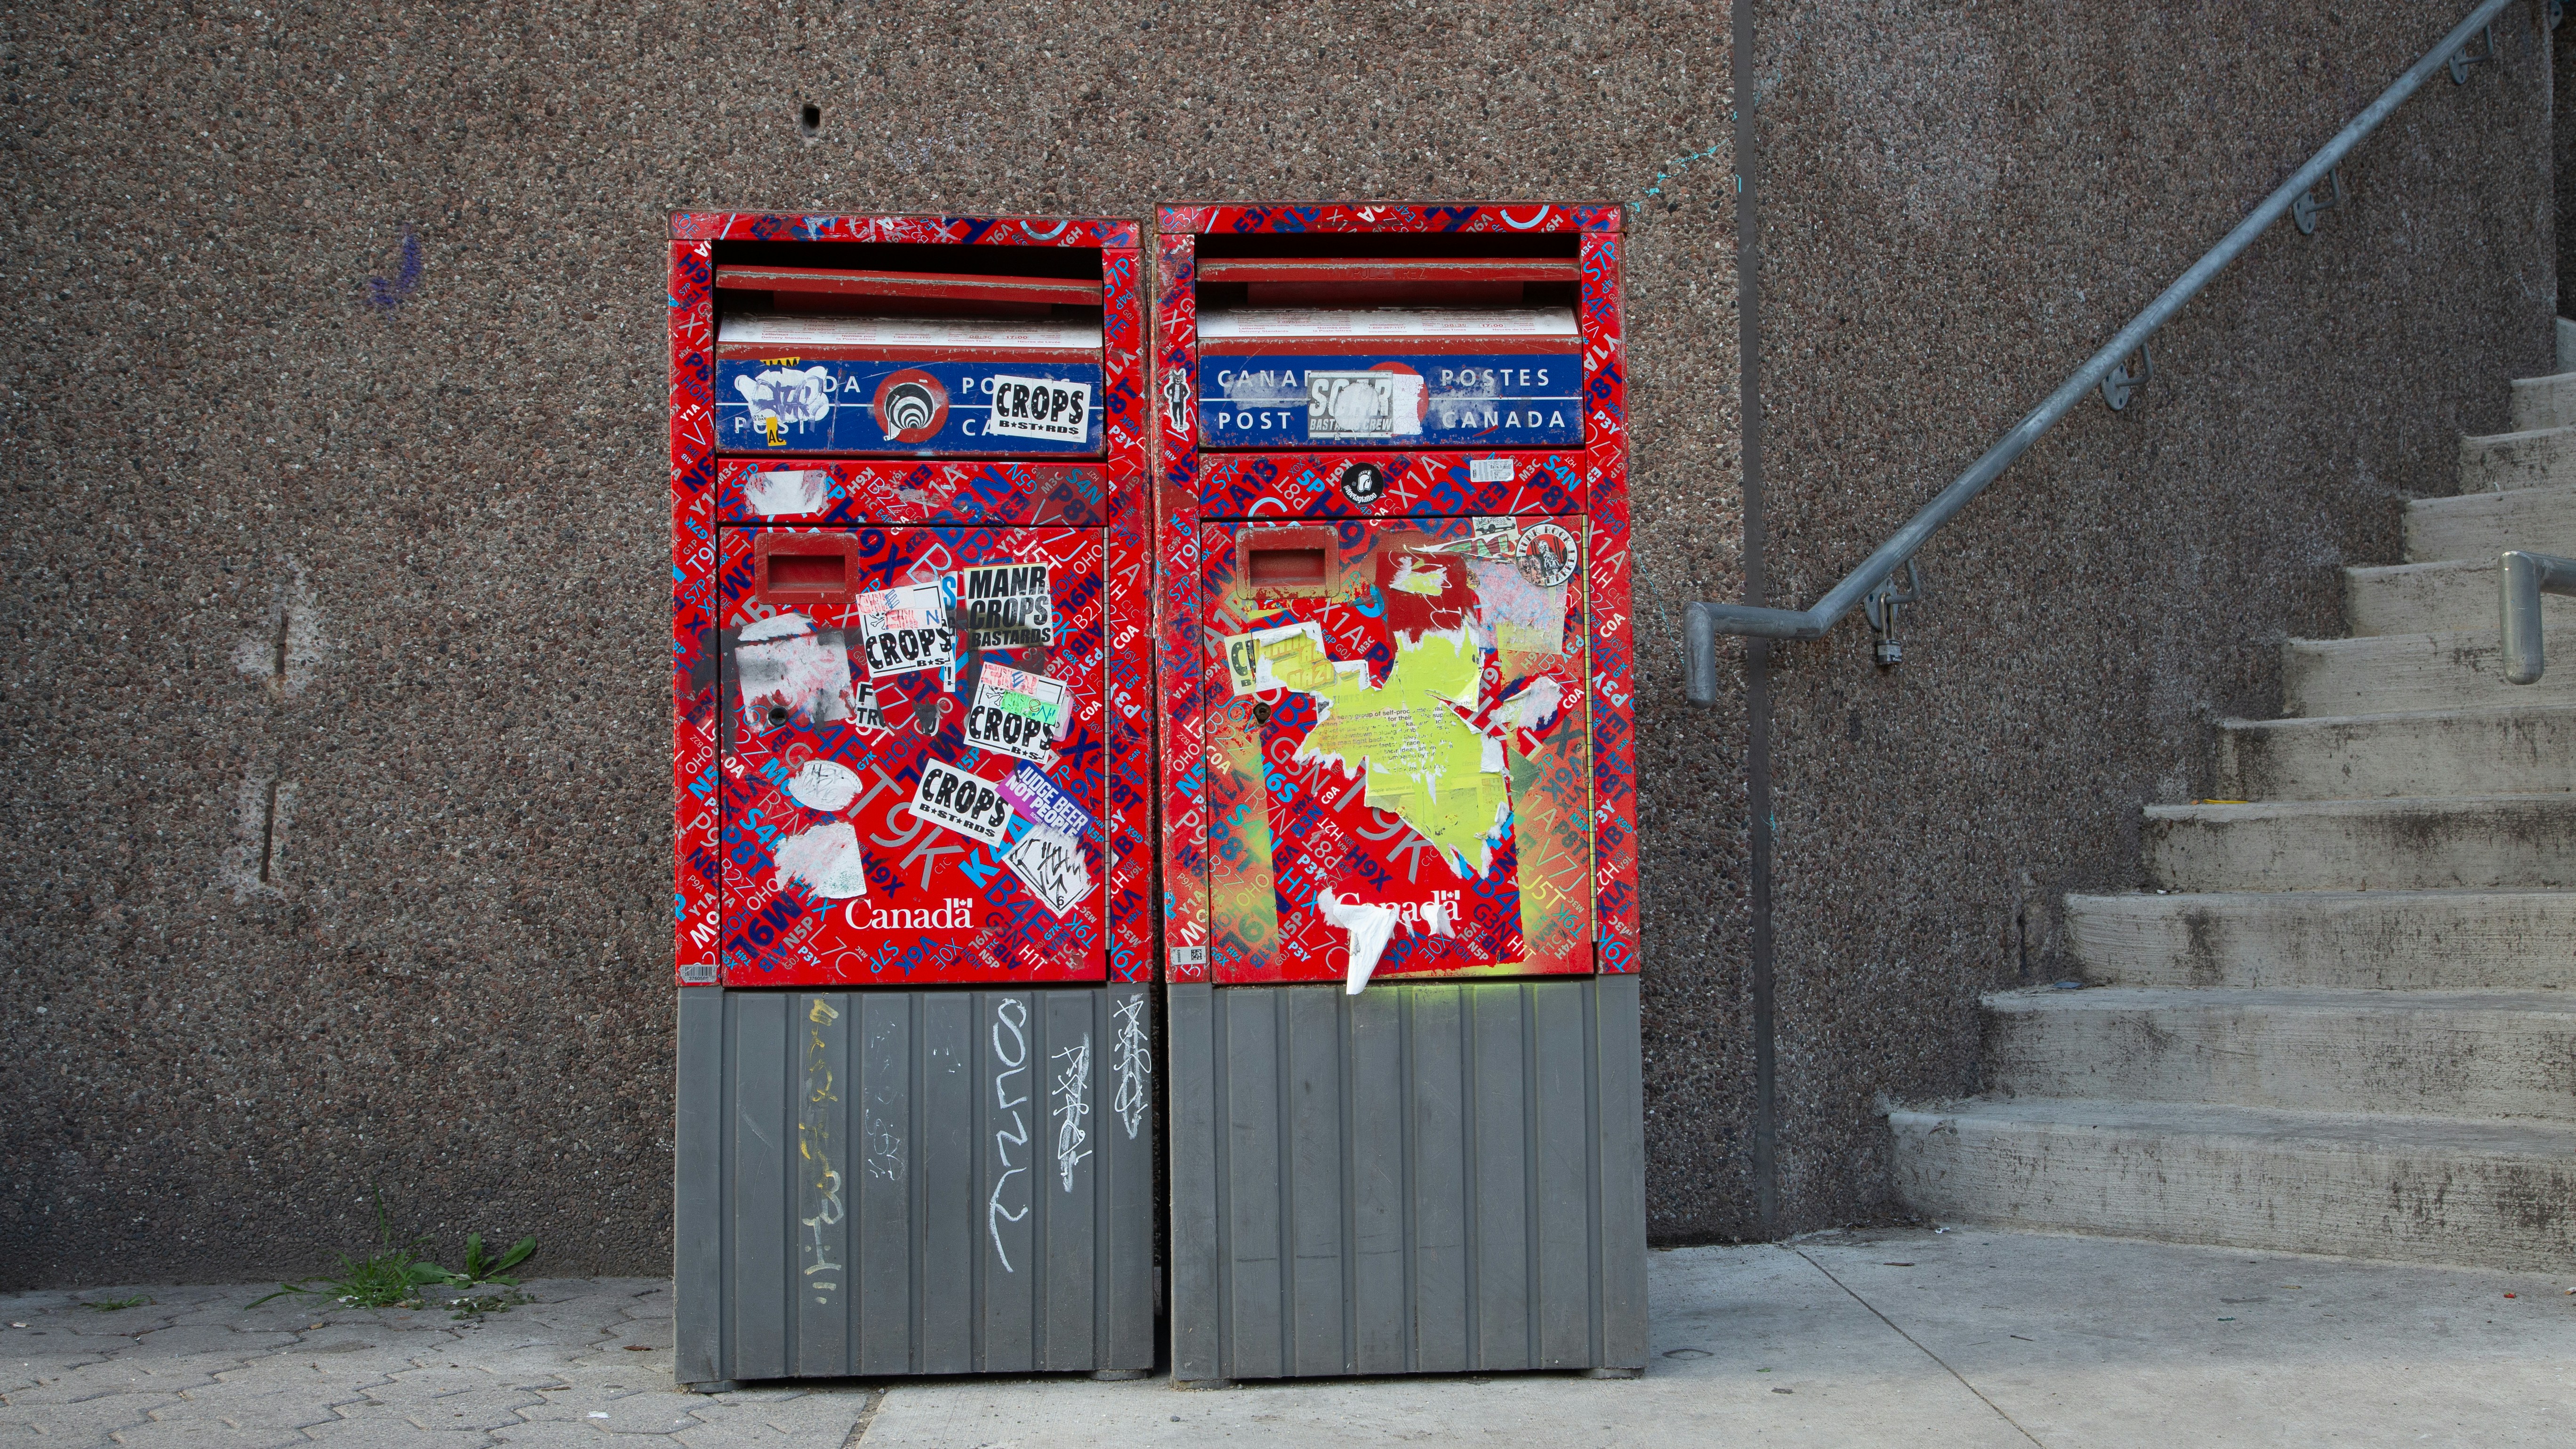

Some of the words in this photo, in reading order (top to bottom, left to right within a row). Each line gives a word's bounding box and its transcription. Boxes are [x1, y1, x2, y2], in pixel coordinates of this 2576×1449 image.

[1583, 242, 1616, 281] S7P
[1585, 333, 1620, 371] Y1A
[1442, 370, 1549, 386] POSTES
[680, 404, 700, 421] Y1A
[997, 383, 1084, 425] CROPS
[1219, 412, 1291, 429] POST
[1442, 411, 1565, 428] CANADA
[1594, 410, 1620, 435] P3Y
[1109, 425, 1134, 448] P3Y
[848, 467, 875, 496] K6H
[1006, 464, 1038, 495] G5N
[1040, 471, 1063, 495] M3C
[1212, 459, 1238, 490] S7P
[1229, 458, 1278, 510] A1B
[1390, 455, 1446, 508] X1A
[1518, 459, 1541, 482] M3C
[1543, 455, 1582, 492] S4N
[860, 492, 877, 510] T1C
[1065, 468, 1103, 505] S4N
[1272, 475, 1311, 511] P8T
[1527, 471, 1582, 517] P8T
[997, 527, 1027, 553] Y1A
[1519, 528, 1538, 554] PUNK
[1544, 525, 1572, 545] ROCK
[1546, 549, 1576, 584] MARKET
[684, 580, 706, 604] S7P
[968, 566, 1046, 599] MANR
[1169, 576, 1189, 602] S7P
[969, 596, 1049, 630] CROPS
[1073, 599, 1103, 629] B2J
[1314, 597, 1366, 651] X1A
[865, 617, 952, 670] CROPS
[972, 627, 1051, 648] BASTARDS
[1357, 636, 1375, 652] M3C
[1080, 647, 1103, 676] P3Y
[1612, 662, 1628, 677] G7K
[1056, 665, 1096, 706] B2Z
[1126, 674, 1141, 689] G7K
[1173, 681, 1192, 700] Y1A
[1592, 672, 1628, 708] P3Y
[969, 705, 1055, 751] CROPS
[1354, 713, 1373, 721] group
[857, 752, 877, 771] G7K
[1129, 749, 1141, 762] S4N
[1607, 751, 1632, 775] N5P
[1119, 763, 1144, 786] N5P
[1594, 764, 1632, 801] P8T
[922, 768, 1009, 828] CROPS
[1005, 774, 1035, 803] NOT
[1029, 796, 1080, 837] PEOPLE
[1017, 766, 1059, 805] JUDGE
[1052, 796, 1089, 832] BEER
[1126, 825, 1143, 843] G6X
[1290, 805, 1323, 837] B3N
[1317, 817, 1344, 842] H2T
[1615, 815, 1633, 834] G6X
[722, 824, 774, 877] P8T
[1302, 837, 1343, 869] P8T
[1420, 849, 1439, 868] C1C
[1536, 837, 1587, 893] V7J
[861, 852, 905, 899] H9X
[934, 857, 951, 875] C1C
[1344, 847, 1393, 893] H9X
[688, 894, 716, 916] Y1A
[1278, 867, 1319, 917] H1X
[1522, 875, 1567, 910] J5T
[845, 898, 974, 929] Canada
[985, 875, 1054, 943] B4E
[1554, 902, 1586, 940] T9K
[783, 917, 813, 950] N5P
[1044, 924, 1061, 941] G7K
[1065, 913, 1097, 949] T9K
[1117, 924, 1142, 947] M3C
[1278, 912, 1303, 945] N5P
[759, 943, 788, 972] A1B
[798, 946, 821, 967] P3Y
[870, 940, 899, 973] S7P
[897, 936, 938, 977] V6K
[978, 949, 1000, 969] N5P
[994, 943, 1023, 969] A1B
[1019, 944, 1048, 970] H1T
[1288, 941, 1311, 961] P3Y
[1467, 942, 1489, 961] N5P
[1507, 935, 1536, 962] H1T
[1598, 925, 1634, 973] T9K
